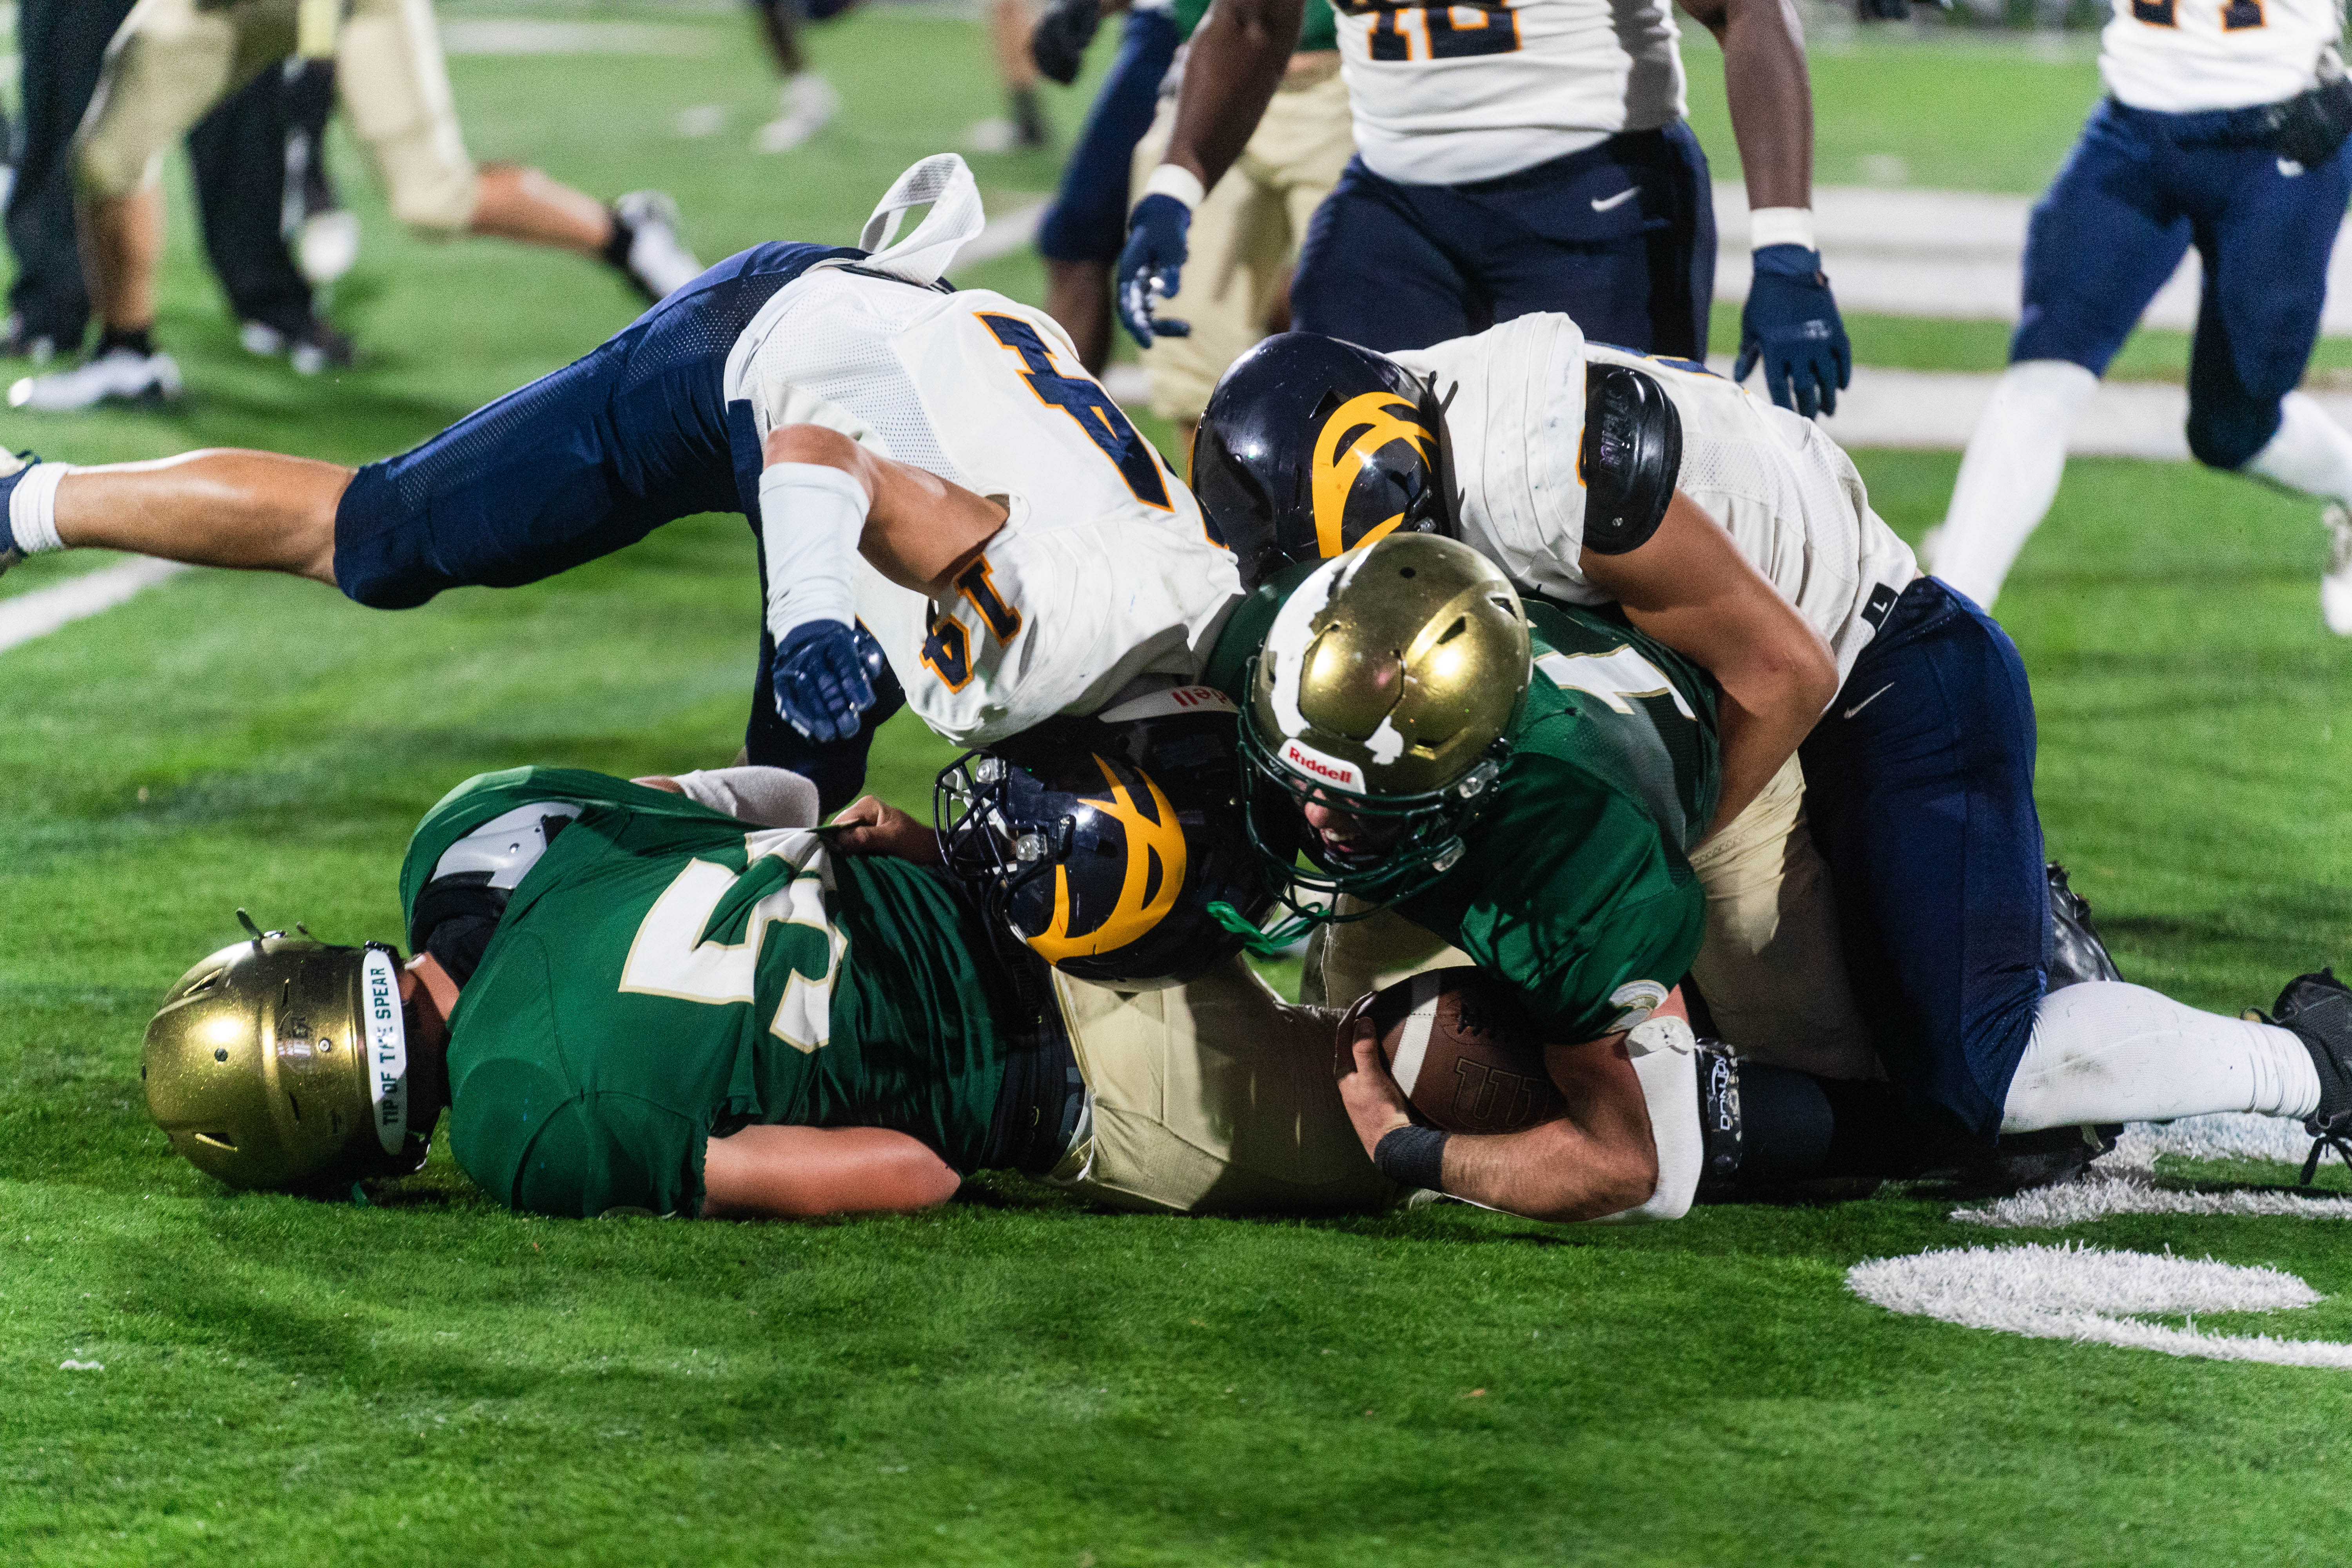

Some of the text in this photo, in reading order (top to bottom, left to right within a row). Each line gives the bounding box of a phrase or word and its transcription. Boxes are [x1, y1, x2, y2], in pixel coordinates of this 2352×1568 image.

[919, 553, 1022, 693] 14
[1289, 746, 1352, 783] Riddell
[370, 967, 391, 1019] SPEAR
[380, 1072, 398, 1093] OF
[383, 1100, 398, 1125] TIP
